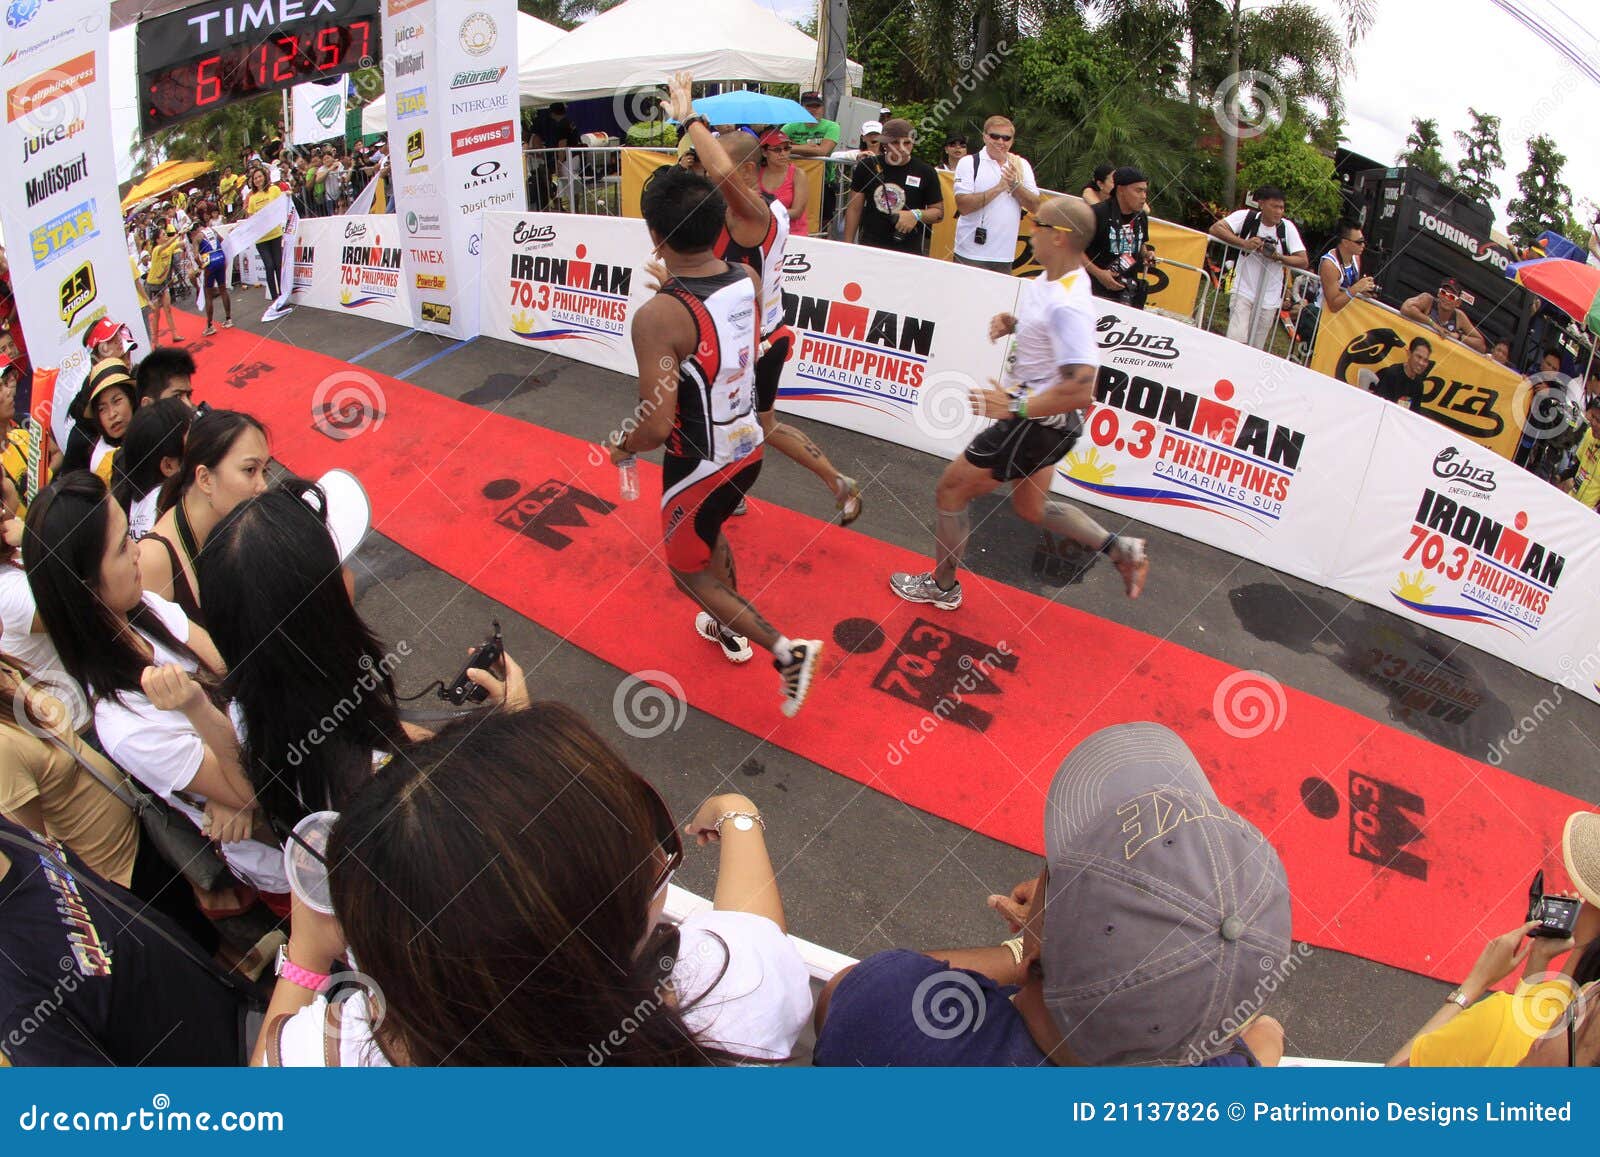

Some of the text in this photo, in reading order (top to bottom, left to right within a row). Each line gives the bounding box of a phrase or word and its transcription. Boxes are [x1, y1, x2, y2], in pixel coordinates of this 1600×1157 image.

[188, 0, 337, 44] TIMEX
[31, 69, 95, 102] airphilexpress
[452, 67, 500, 87] Gatorade
[396, 94, 427, 116] STAR
[452, 95, 509, 115] INTERCARE
[23, 118, 86, 163] juice.ph
[25, 152, 89, 208] MultiSport
[464, 172, 509, 190] OAKLEY
[33, 210, 95, 261] STAR
[513, 221, 557, 245] Cobra
[1418, 211, 1478, 254] TOURING
[341, 265, 361, 287] 70.3
[342, 246, 401, 269] IRONMAN
[410, 249, 444, 265] TIMEX
[511, 254, 633, 297] IRONMAN
[362, 270, 399, 288] PHILIPPINES
[417, 274, 446, 289] PowerBar
[510, 280, 551, 312] 70.3
[552, 310, 624, 332] CAMARINES SUR
[553, 291, 627, 323] PHILIPPINES
[1096, 315, 1180, 360] Cobra
[797, 362, 919, 400] CAMARINES SUR
[799, 338, 925, 388] PHILIPPINES
[1113, 356, 1174, 370] ENERGY DRINK
[1092, 365, 1306, 470] RONMAN
[1154, 461, 1283, 515] CAMARINES SUR
[1158, 435, 1291, 502] PHILIPPINES
[1432, 446, 1497, 492] Cobra
[1448, 486, 1492, 501] ENERGY DRINK
[1403, 524, 1470, 581] 70.3
[1414, 488, 1566, 588] IRONMAN
[1462, 582, 1542, 627] CAMARINES SUR
[1467, 560, 1550, 616] PHILIPPINES
[880, 625, 951, 700] 70.3
[1351, 776, 1381, 857] 70.3
